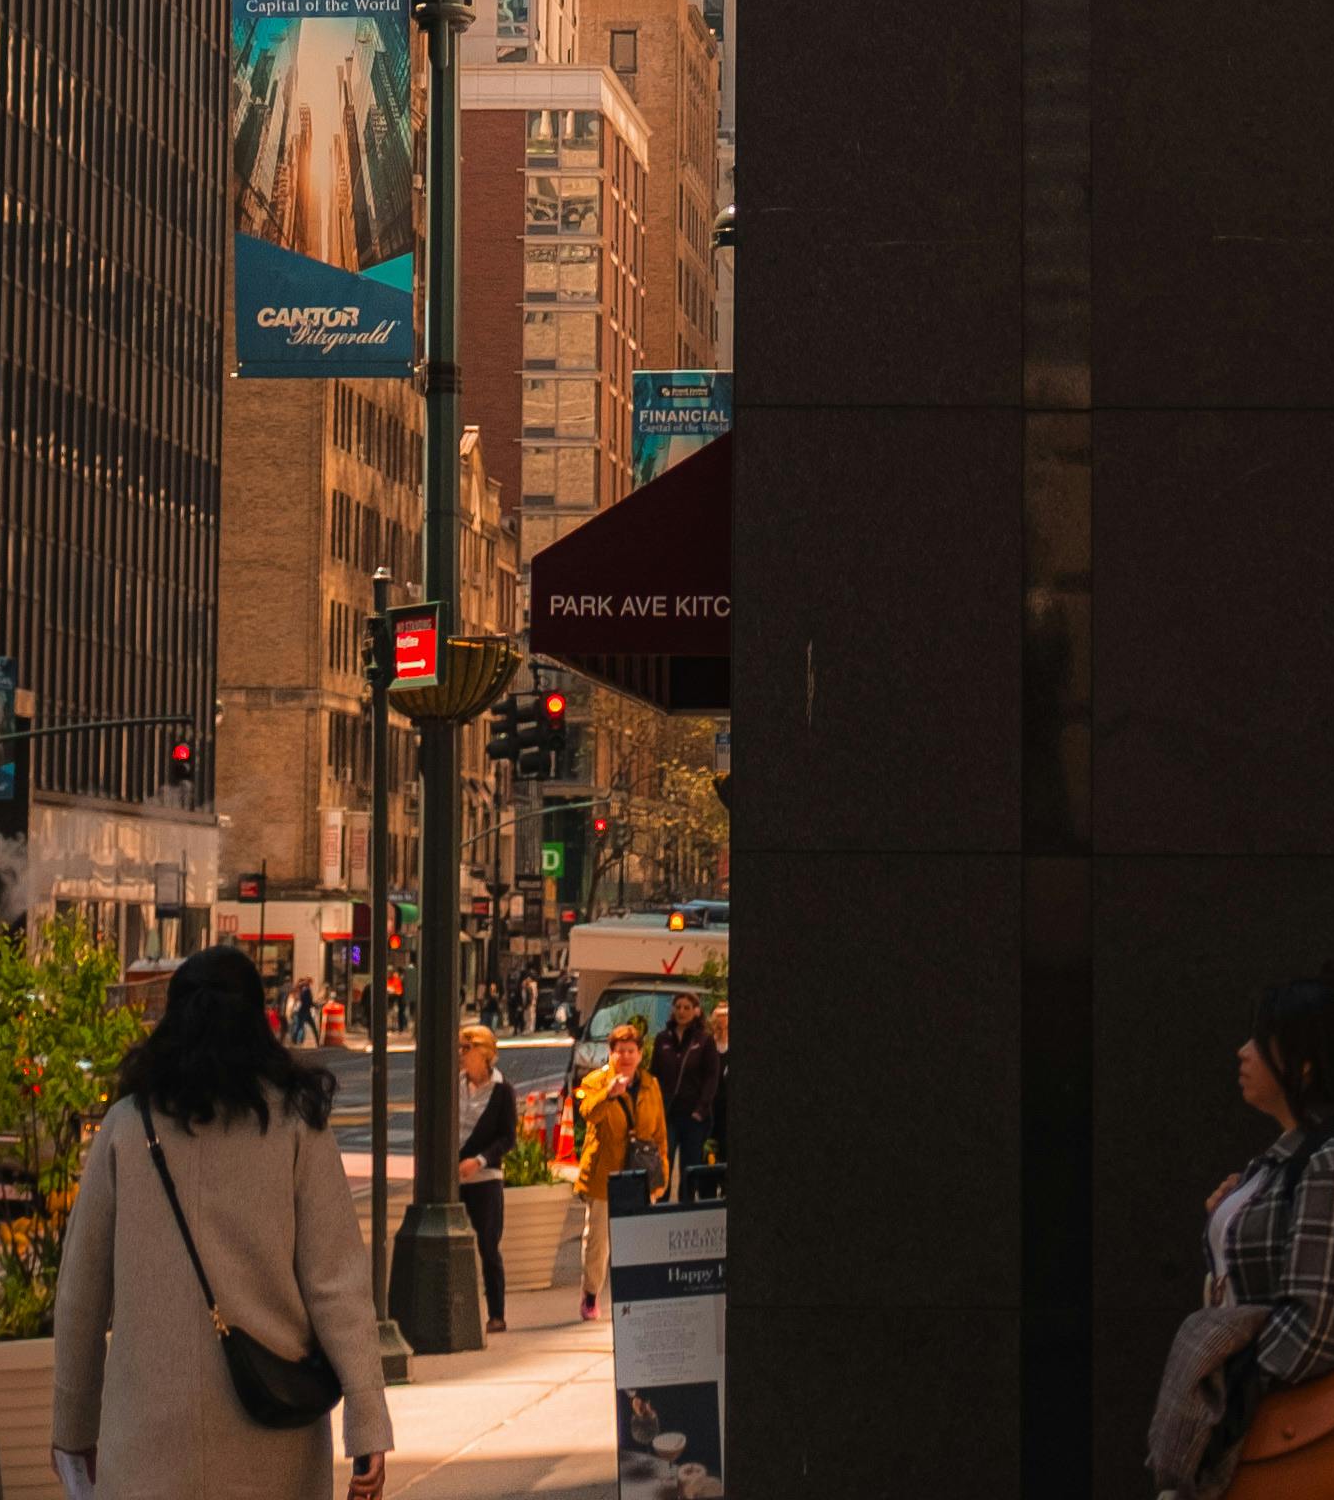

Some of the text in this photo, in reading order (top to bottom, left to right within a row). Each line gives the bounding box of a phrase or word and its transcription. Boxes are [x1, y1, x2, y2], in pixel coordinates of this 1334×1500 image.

[246, 0, 300, 15] Capital
[257, 307, 361, 328] CANTOR
[286, 319, 396, 354] Fitzgerald
[639, 410, 729, 423] FINANCIAL
[550, 595, 731, 617] PARK AVE KITC
[668, 1267, 714, 1284] Happy
